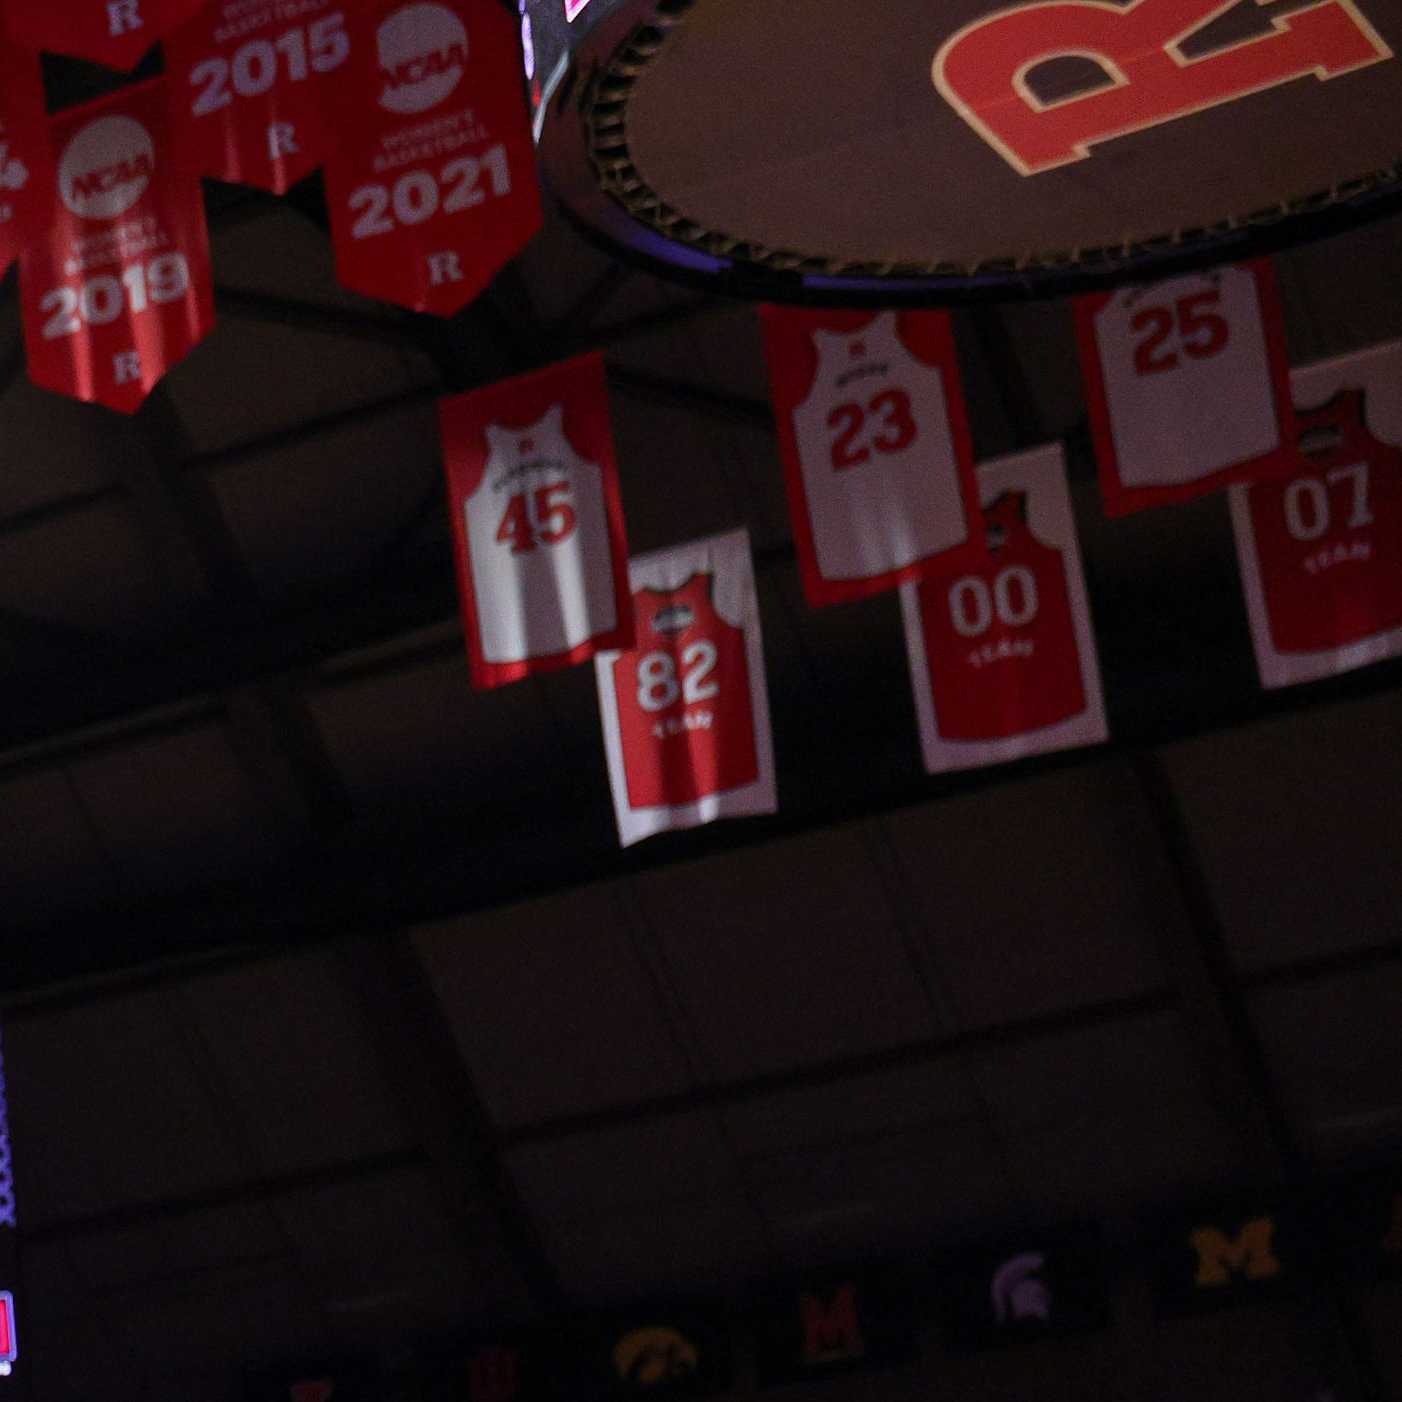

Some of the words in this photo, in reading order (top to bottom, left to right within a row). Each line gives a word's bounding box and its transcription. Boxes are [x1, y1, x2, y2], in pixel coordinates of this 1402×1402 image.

[188, 12, 351, 118] 2015
[266, 122, 301, 160] R
[348, 144, 513, 240] 2021
[39, 251, 190, 340] 2019
[426, 249, 465, 286] R
[112, 349, 142, 386] R
[1130, 290, 1231, 376] 25
[827, 387, 917, 472] 23
[496, 481, 576, 554] 45
[1283, 462, 1374, 543] 07
[948, 564, 1039, 637] 00
[637, 640, 721, 713] 82
[1187, 1213, 1284, 1291] M
